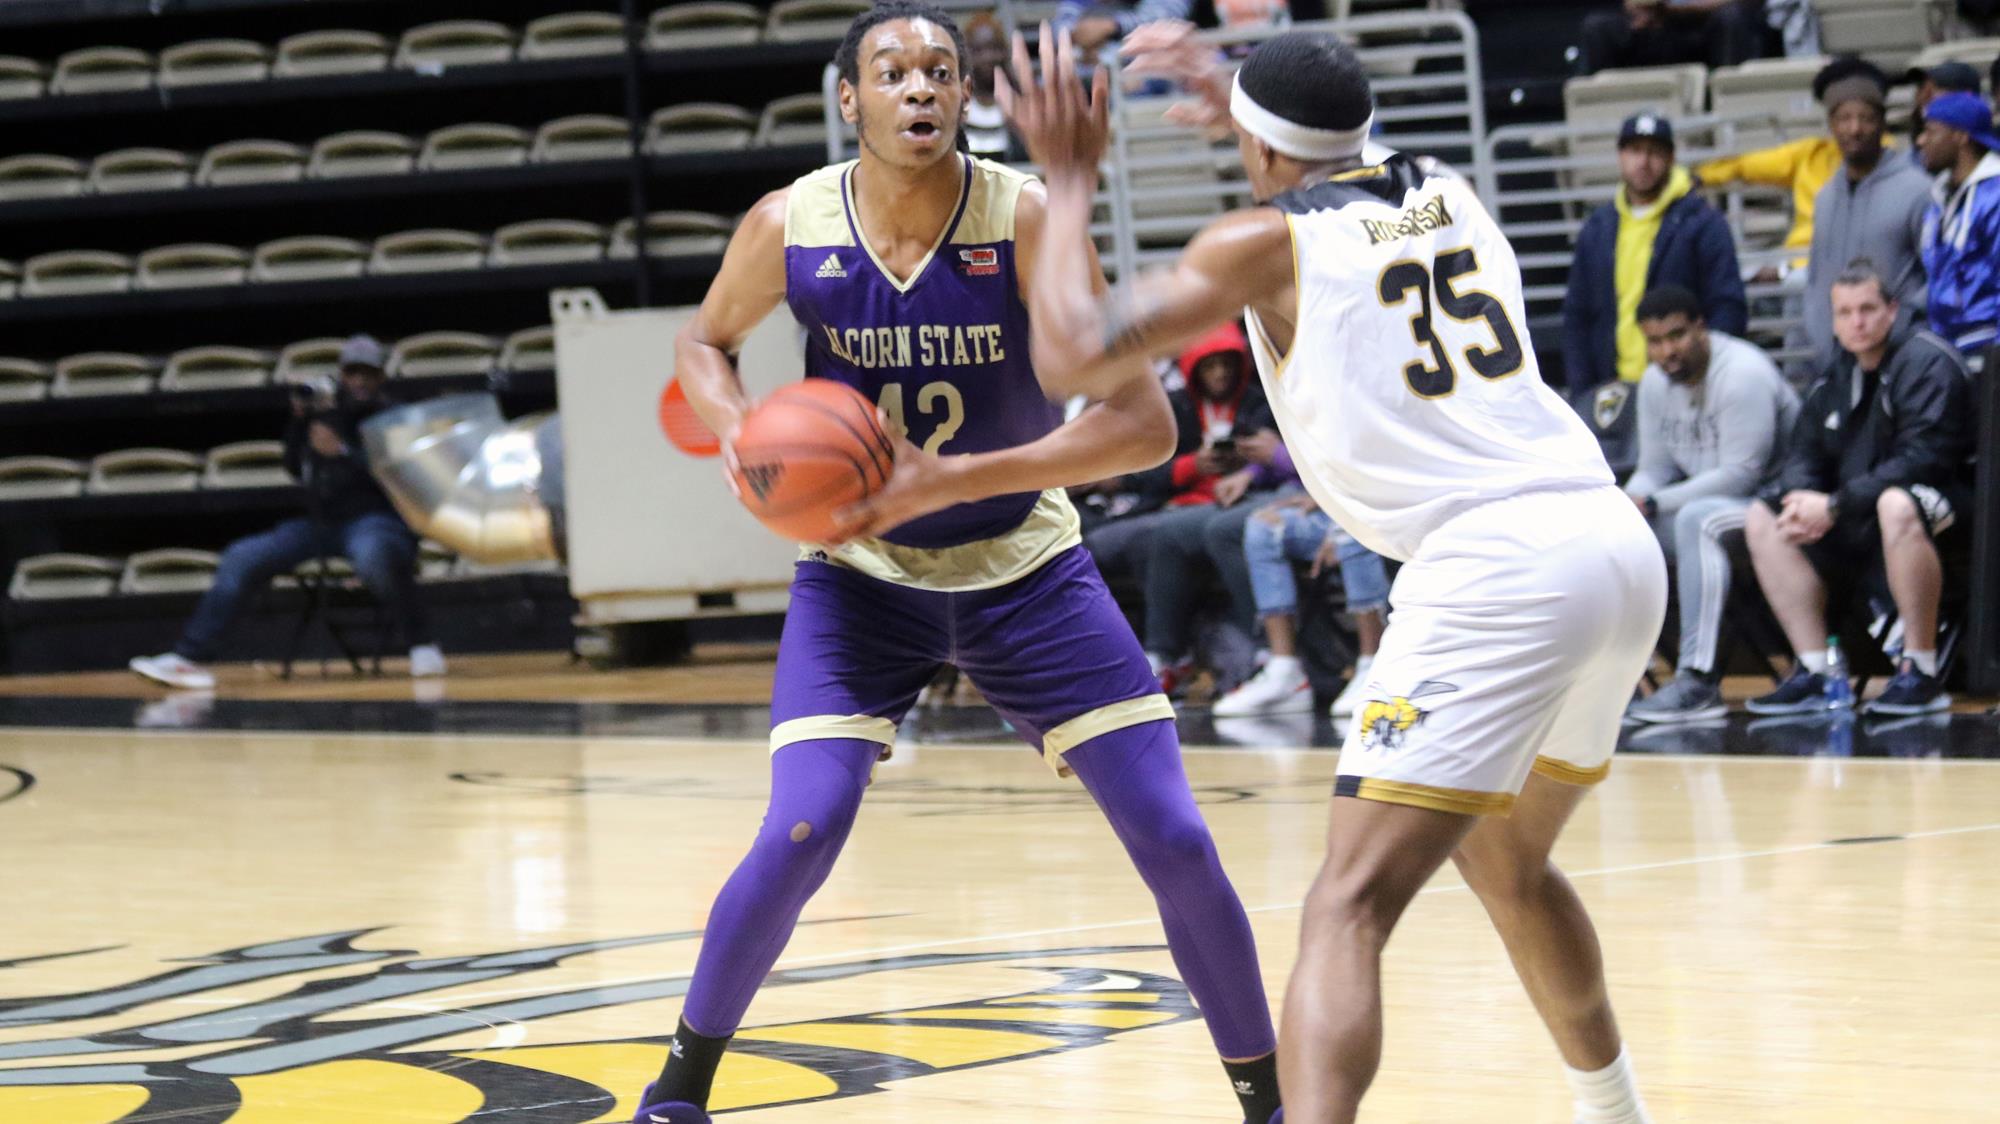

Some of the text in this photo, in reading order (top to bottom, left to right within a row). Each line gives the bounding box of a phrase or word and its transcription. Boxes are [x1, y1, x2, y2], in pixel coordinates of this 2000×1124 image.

[815, 269, 848, 278] adidas
[918, 324, 1005, 367] STATE
[1376, 246, 1525, 400] 35
[876, 381, 970, 458] 42
